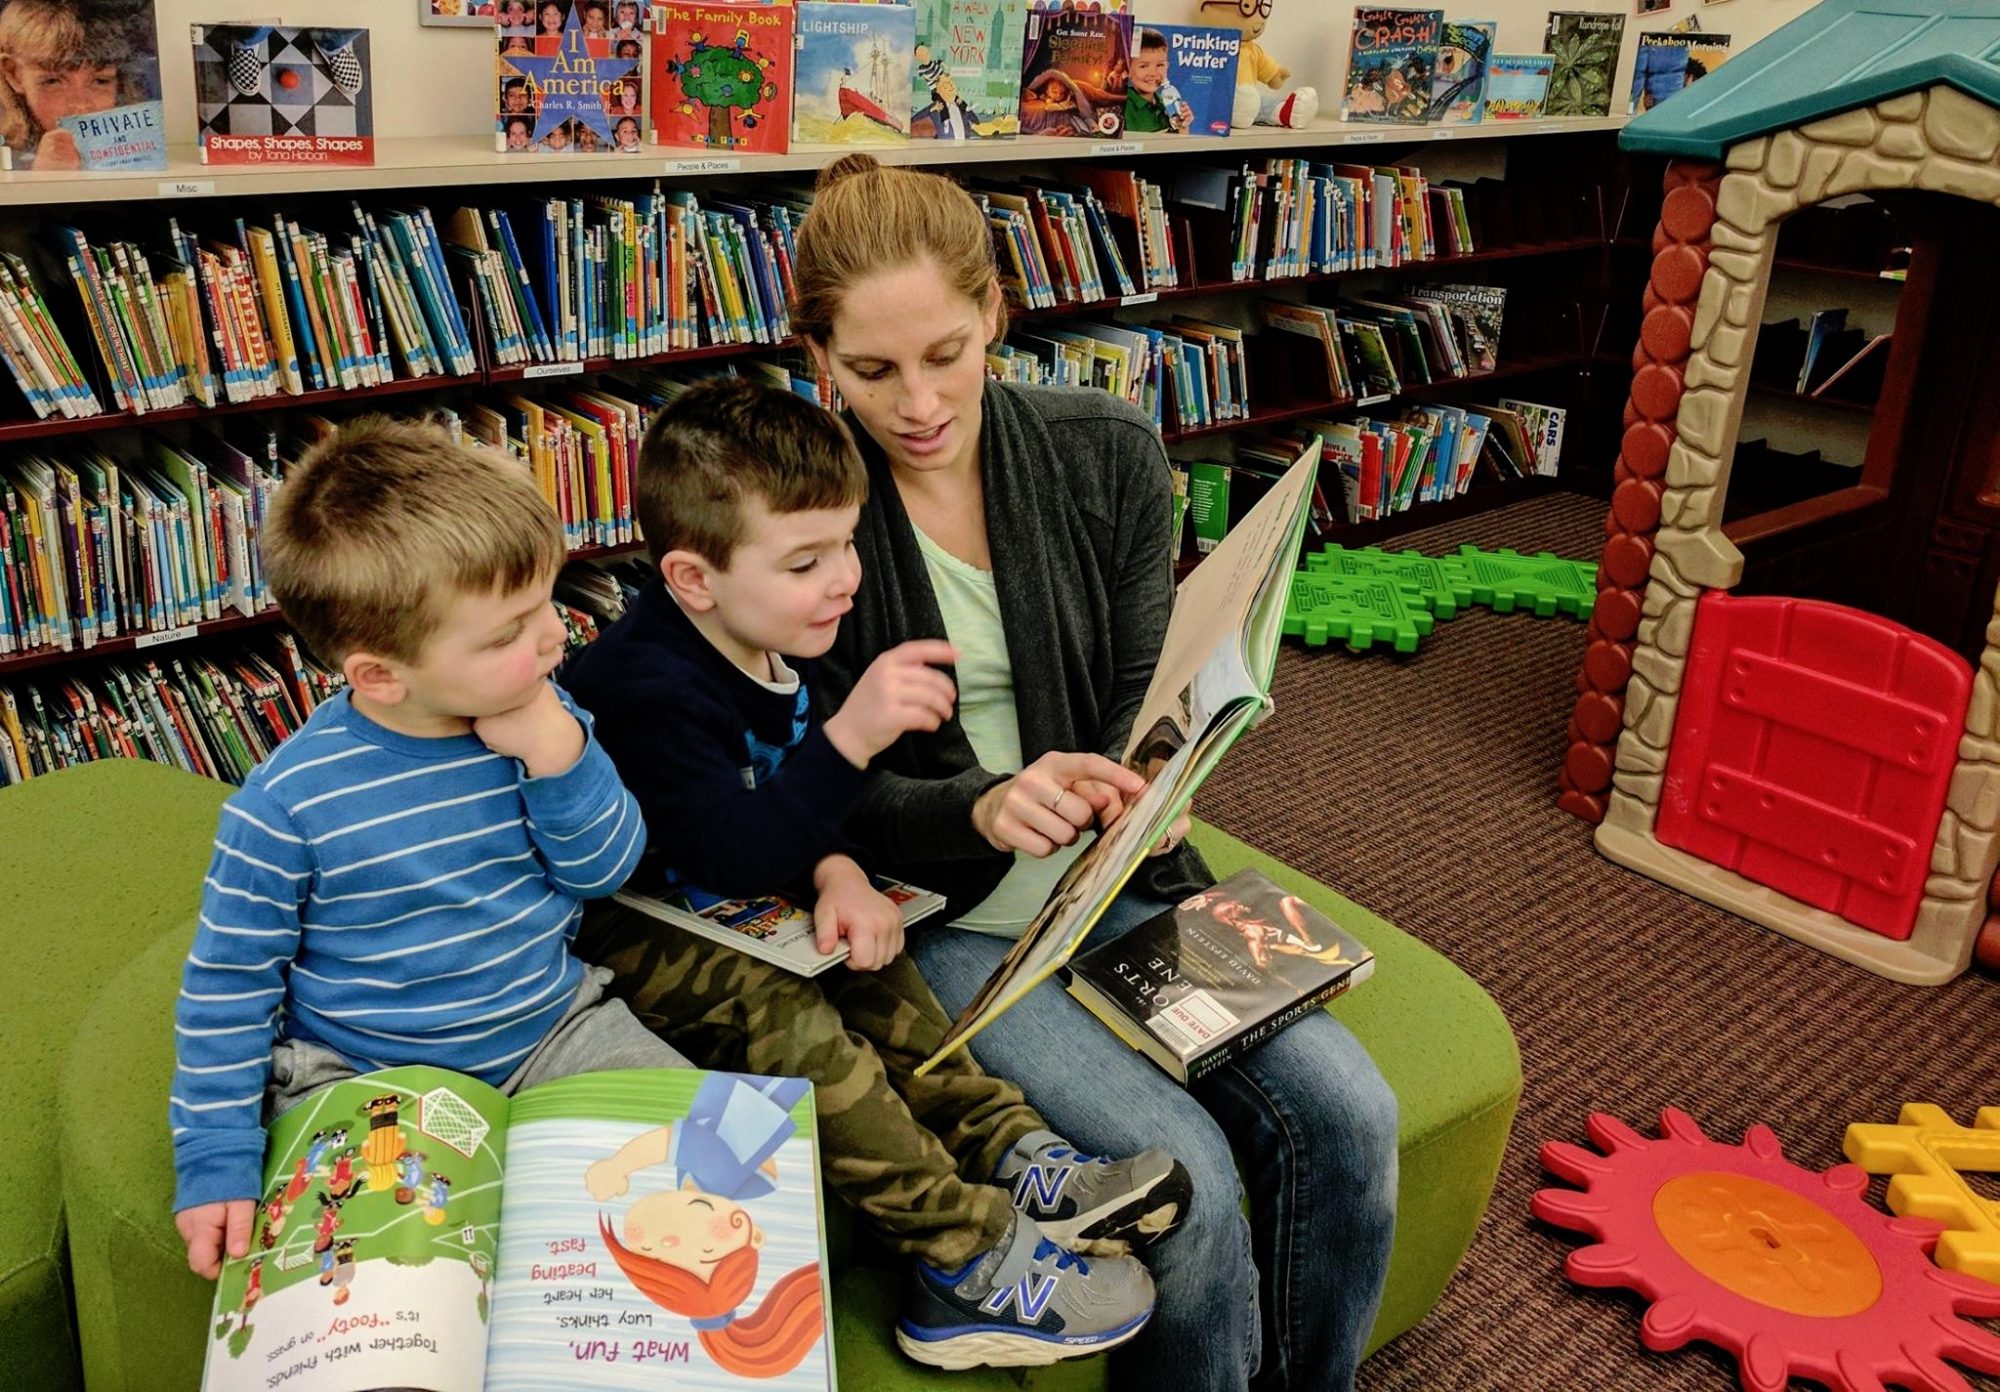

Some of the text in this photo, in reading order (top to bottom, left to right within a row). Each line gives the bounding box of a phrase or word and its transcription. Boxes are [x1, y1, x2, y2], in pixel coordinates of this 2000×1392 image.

[665, 7, 781, 27] The Family Book
[966, 15, 975, 24] IN
[802, 21, 869, 34] LIGHTSHIP
[953, 25, 987, 43] NEW
[1355, 21, 1437, 50] CRASH!
[568, 29, 579, 53] I
[1172, 33, 1240, 56] Drinking
[1640, 35, 1686, 46] Peekaboo
[550, 49, 596, 74] Am
[950, 46, 985, 65] YORK
[1177, 50, 1228, 69] Water
[520, 70, 625, 95] America
[531, 100, 564, 110] Charles
[577, 101, 602, 110] Smith
[78, 109, 154, 138] PRIVATE
[113, 134, 127, 144] AND
[210, 136, 364, 152] Shapes, Shapes, Shapes
[89, 141, 158, 161] CONFIDENTIAL
[248, 150, 328, 162] by Tana Hoban
[176, 184, 198, 193] Misc
[1411, 285, 1504, 304] Transportation
[536, 366, 571, 376] Ourselves
[1546, 411, 1560, 447] CARS
[152, 631, 182, 643] Nature
[1185, 927, 1229, 960] EPSTEIN
[1147, 957, 1193, 992] ENE
[1228, 959, 1262, 986] DAVID
[1113, 962, 1170, 1007] ORTS
[1170, 1006, 1211, 1040] DATE DUE
[1240, 1025, 1267, 1048] THE
[1270, 996, 1317, 1031] SPORTS
[1196, 1054, 1233, 1079] EPSTEIN
[1201, 1048, 1229, 1068] DAVID
[545, 1238, 587, 1256] fast.
[531, 1262, 597, 1282] beating
[543, 1287, 614, 1306] her heart
[556, 1310, 653, 1329] Lucy thinks.
[300, 1331, 315, 1345] on
[369, 1333, 439, 1354] Together
[1062, 1334, 1100, 1345] SPEED
[324, 1342, 362, 1363] with
[569, 1340, 691, 1363] What fun,
